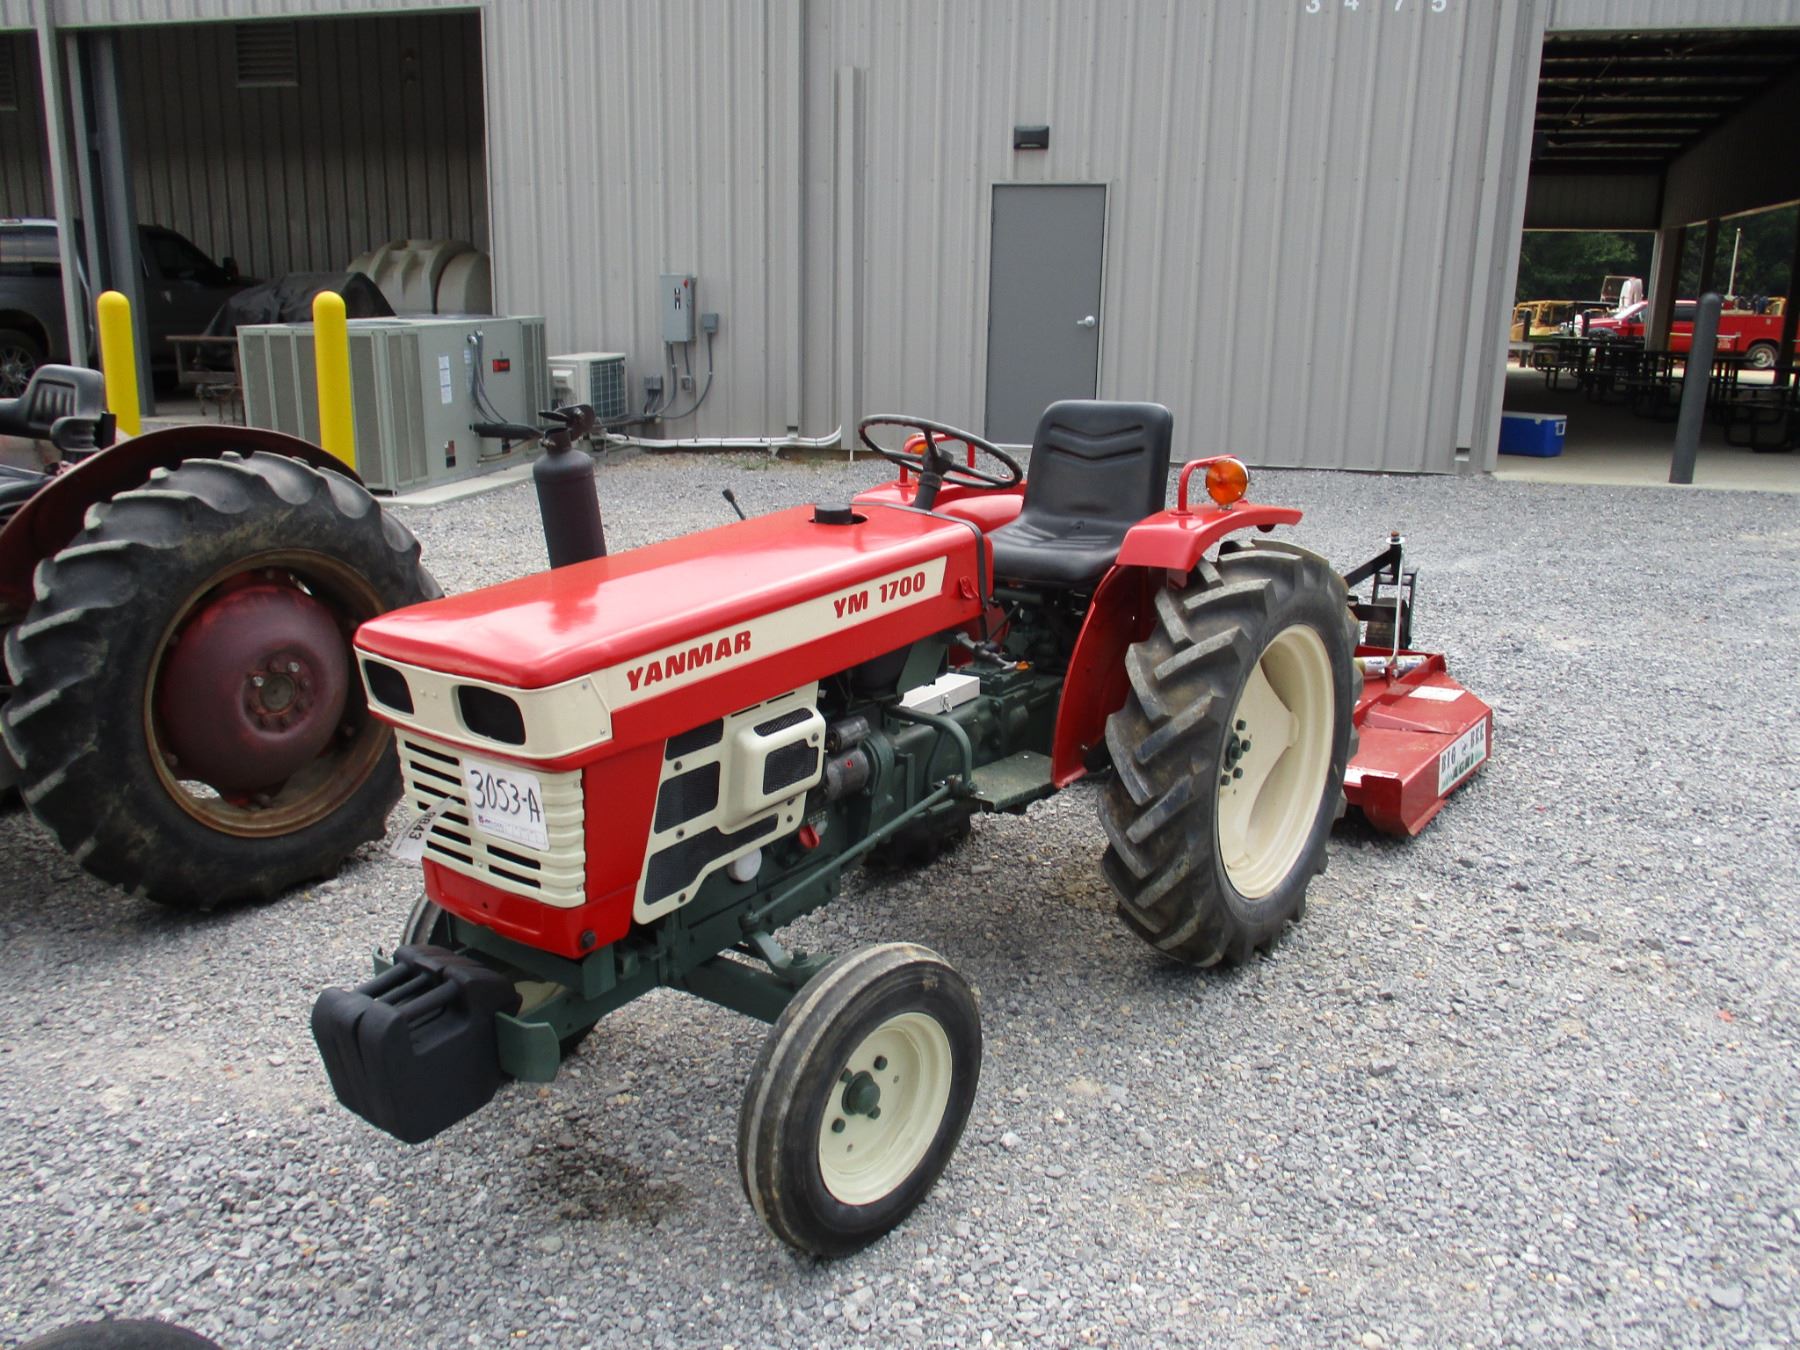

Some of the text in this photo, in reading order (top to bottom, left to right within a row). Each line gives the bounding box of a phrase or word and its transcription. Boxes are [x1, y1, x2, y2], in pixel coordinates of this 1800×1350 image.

[833, 571, 926, 619] YM 1700
[626, 630, 752, 692] YANMAR
[470, 769, 541, 823] 3053-A
